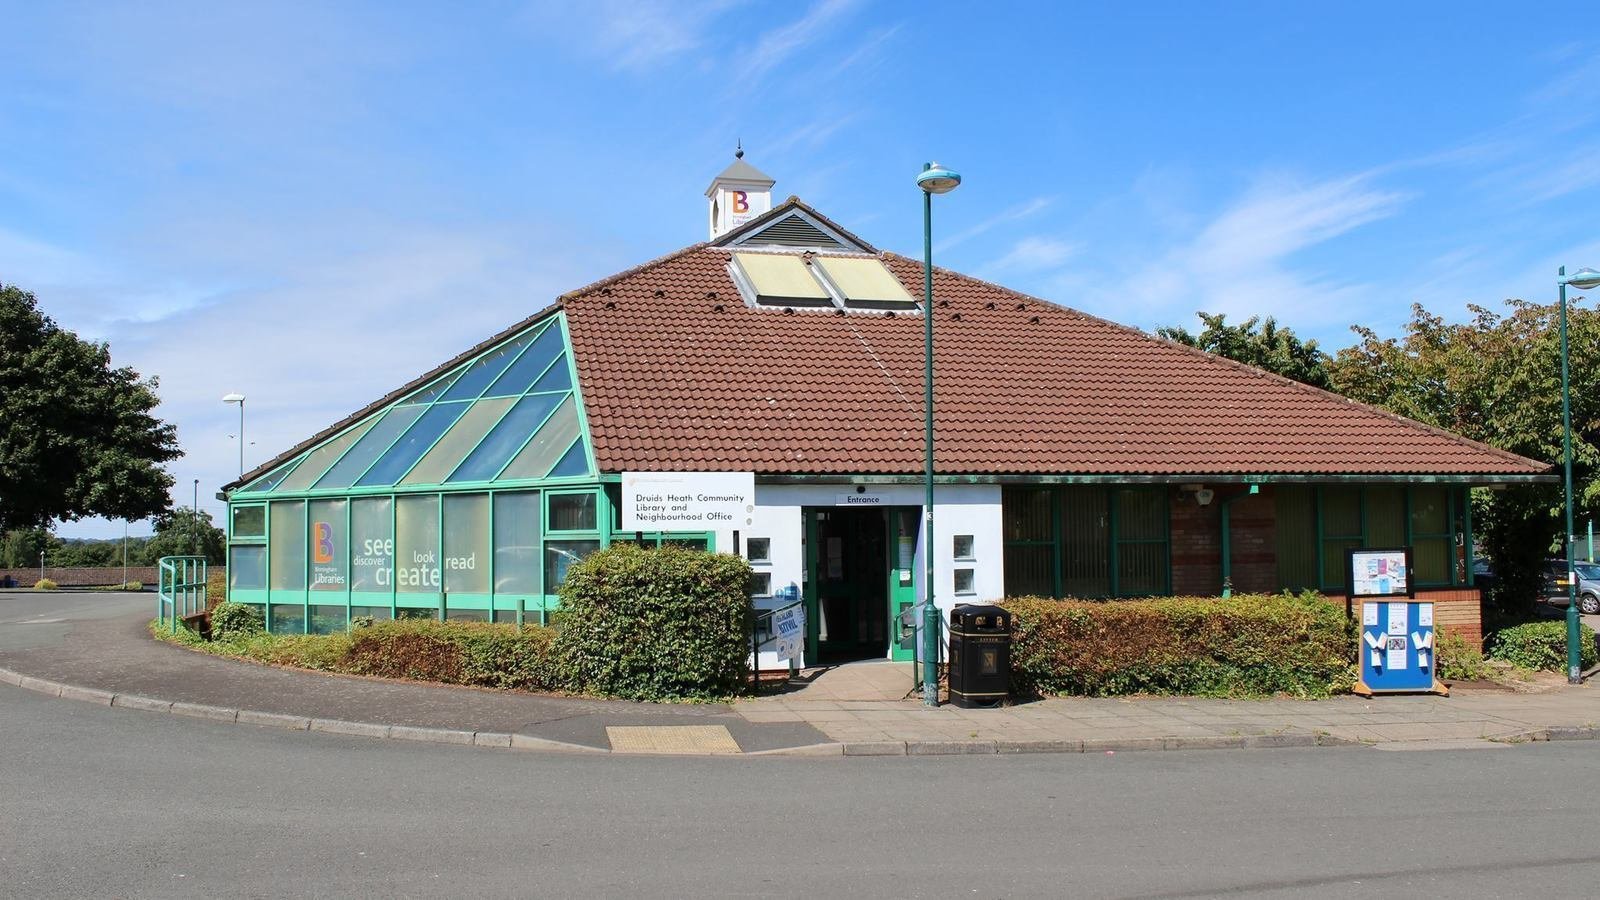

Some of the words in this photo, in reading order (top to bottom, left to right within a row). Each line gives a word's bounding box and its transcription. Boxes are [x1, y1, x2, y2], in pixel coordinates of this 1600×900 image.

[733, 190, 749, 213] B
[697, 494, 744, 503] Community
[636, 504, 666, 513] Library
[636, 513, 702, 522] Neighbourhood
[706, 512, 733, 520] Office
[314, 522, 335, 564] B
[364, 538, 393, 556] see
[353, 554, 385, 566] discover
[413, 550, 435, 563] look
[445, 552, 475, 570] read
[314, 573, 345, 584] Libraries
[375, 563, 440, 587] create
